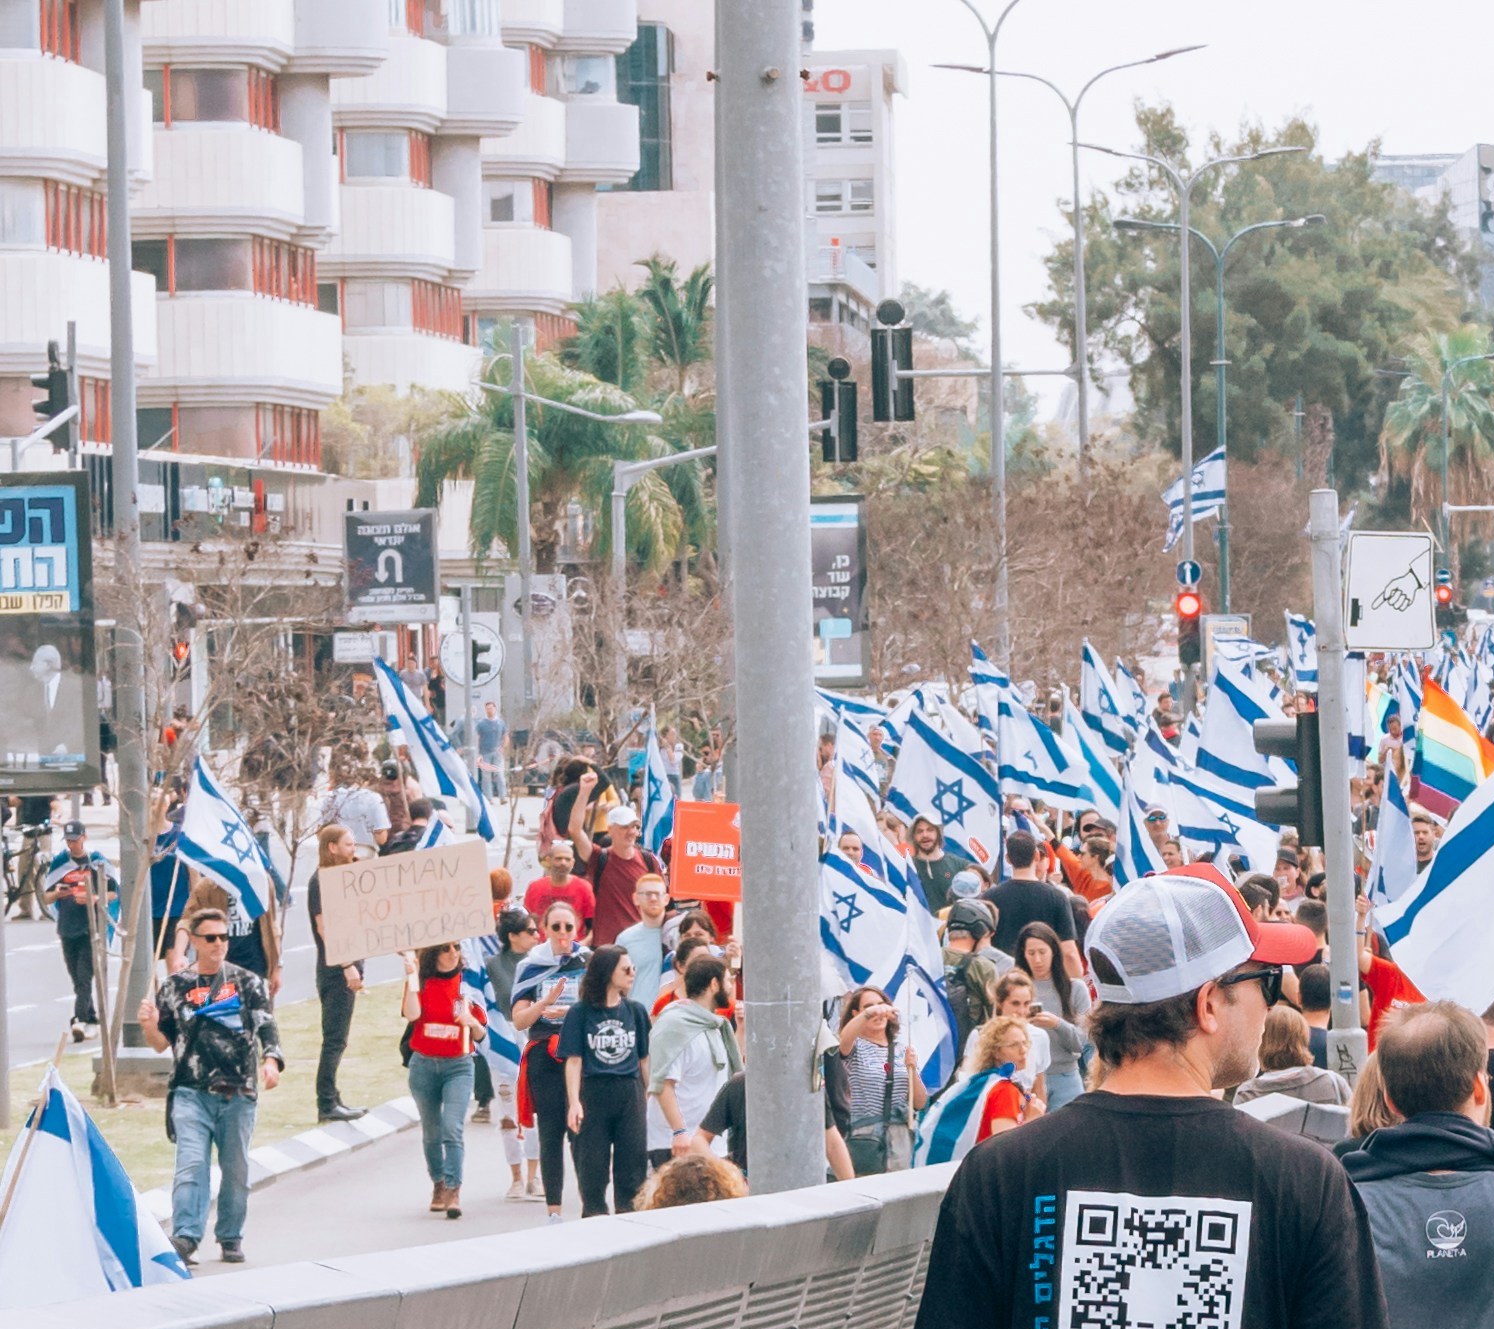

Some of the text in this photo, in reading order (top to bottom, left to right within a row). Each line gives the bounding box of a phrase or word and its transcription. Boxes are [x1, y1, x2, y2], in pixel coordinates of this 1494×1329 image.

[32, 594, 63, 610] קפלן
[342, 855, 461, 899] ROTMAN
[365, 908, 491, 953] DEMOCRACY
[587, 1030, 636, 1050] VIPERS
[1029, 1194, 1056, 1305] הדגלים
